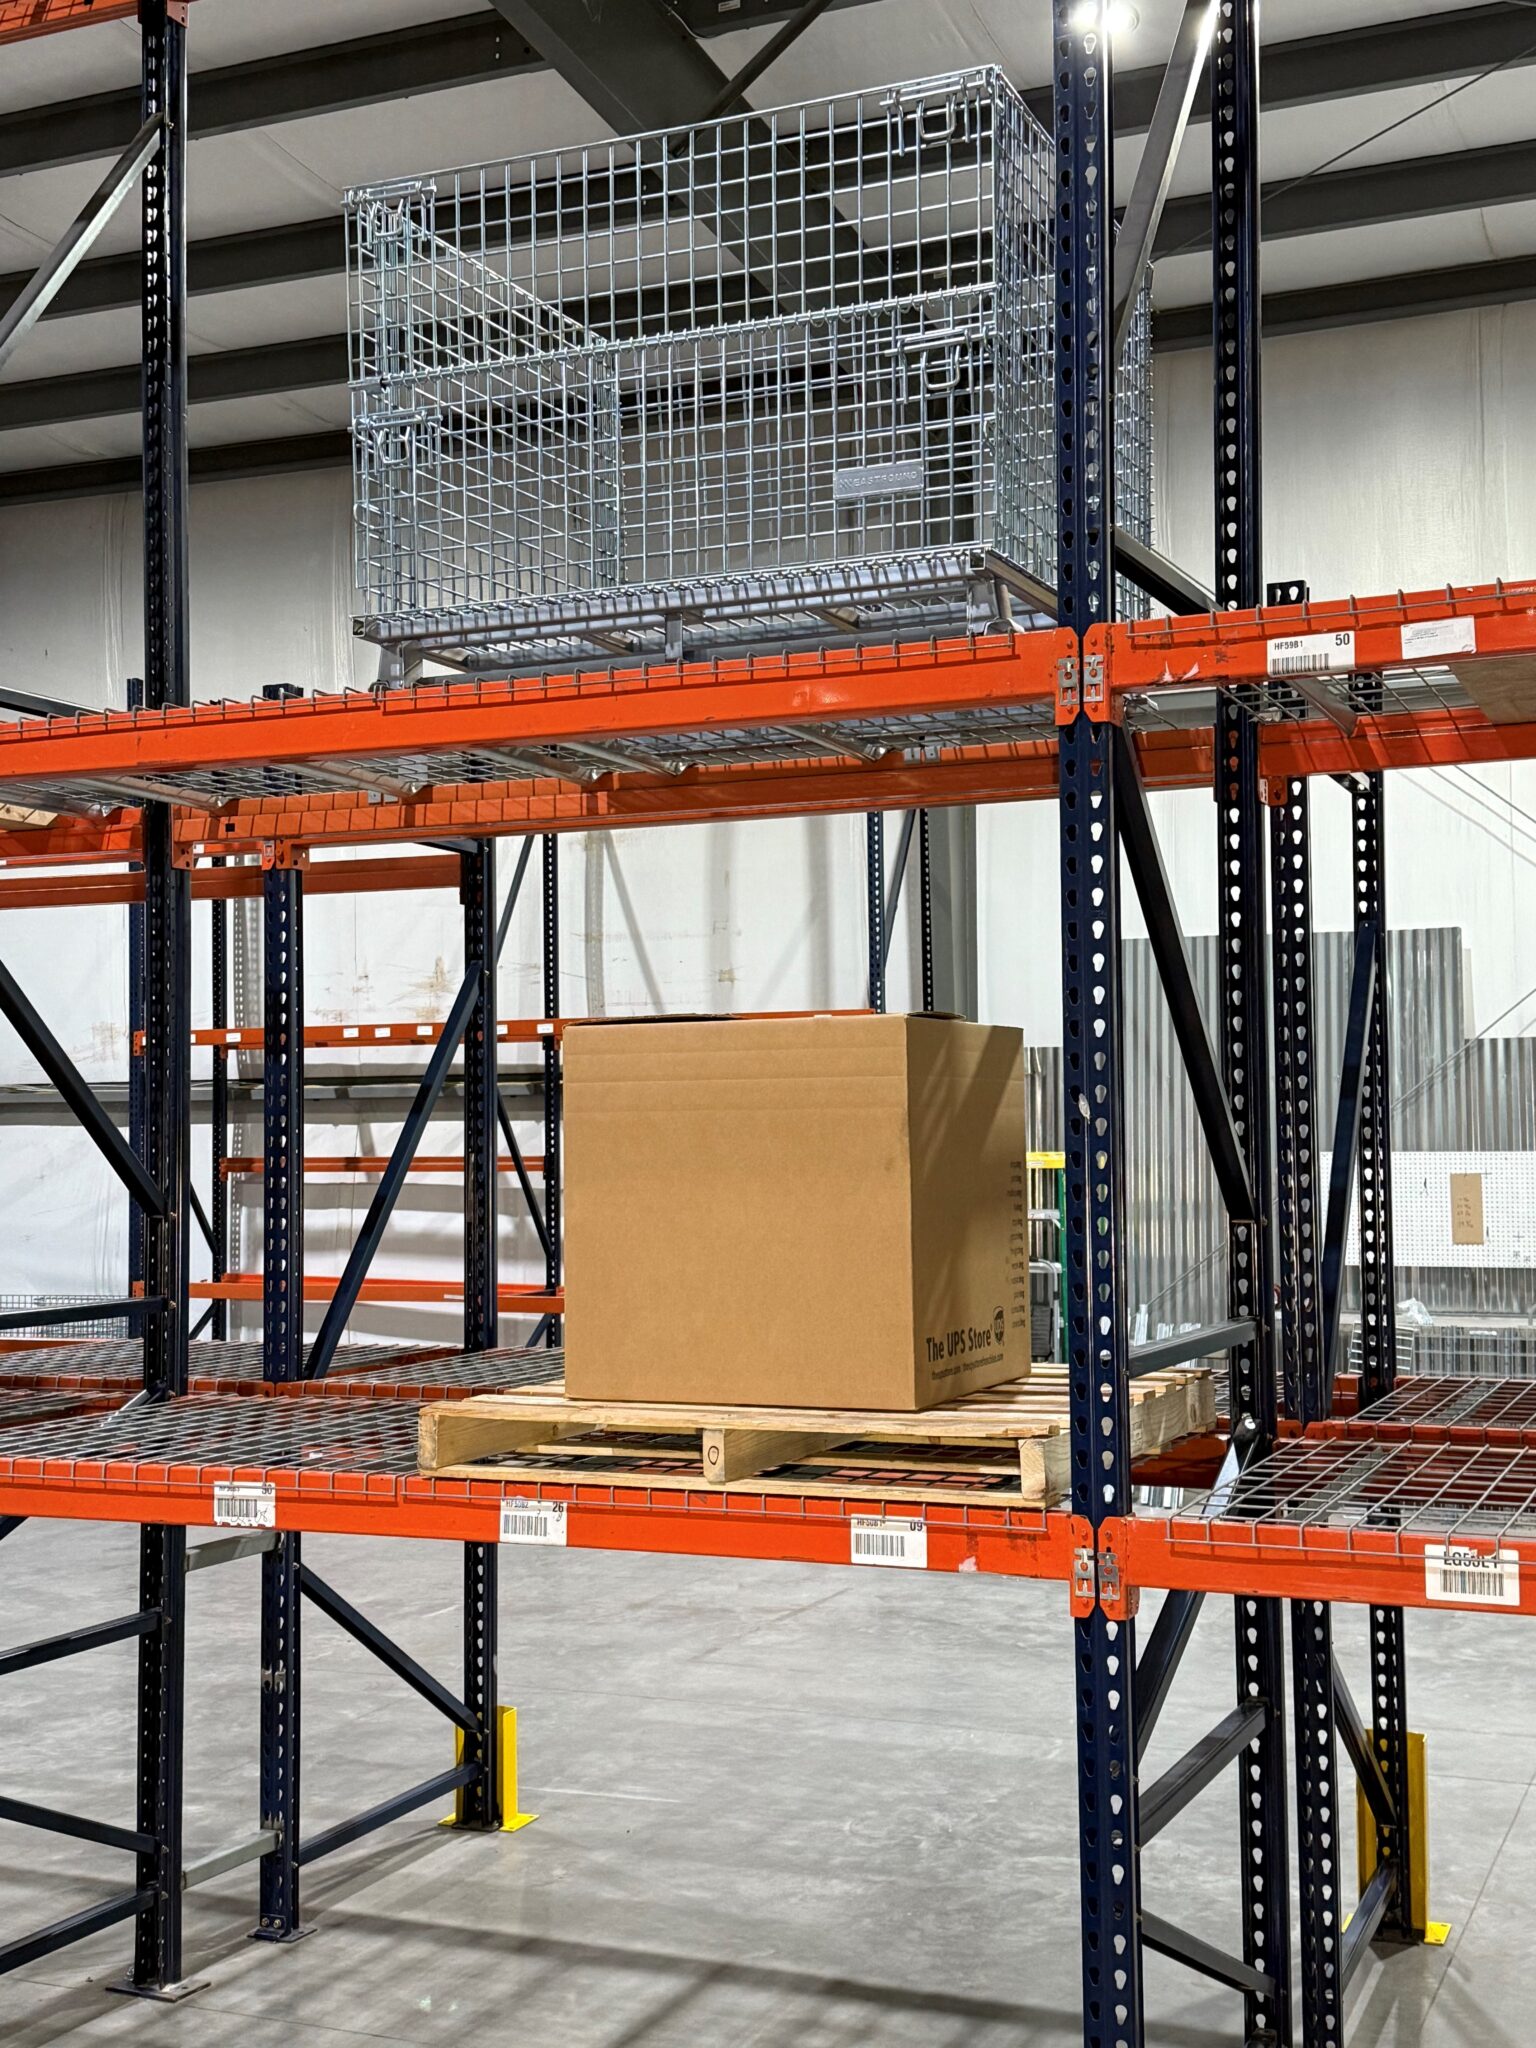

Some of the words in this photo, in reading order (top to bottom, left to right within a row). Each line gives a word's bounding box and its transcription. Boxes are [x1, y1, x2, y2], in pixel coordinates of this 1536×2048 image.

[1335, 633, 1350, 647] 50
[926, 1336, 945, 1363] The
[946, 1328, 966, 1358] UPS
[968, 1326, 991, 1352] Store
[552, 1501, 564, 1513] 26
